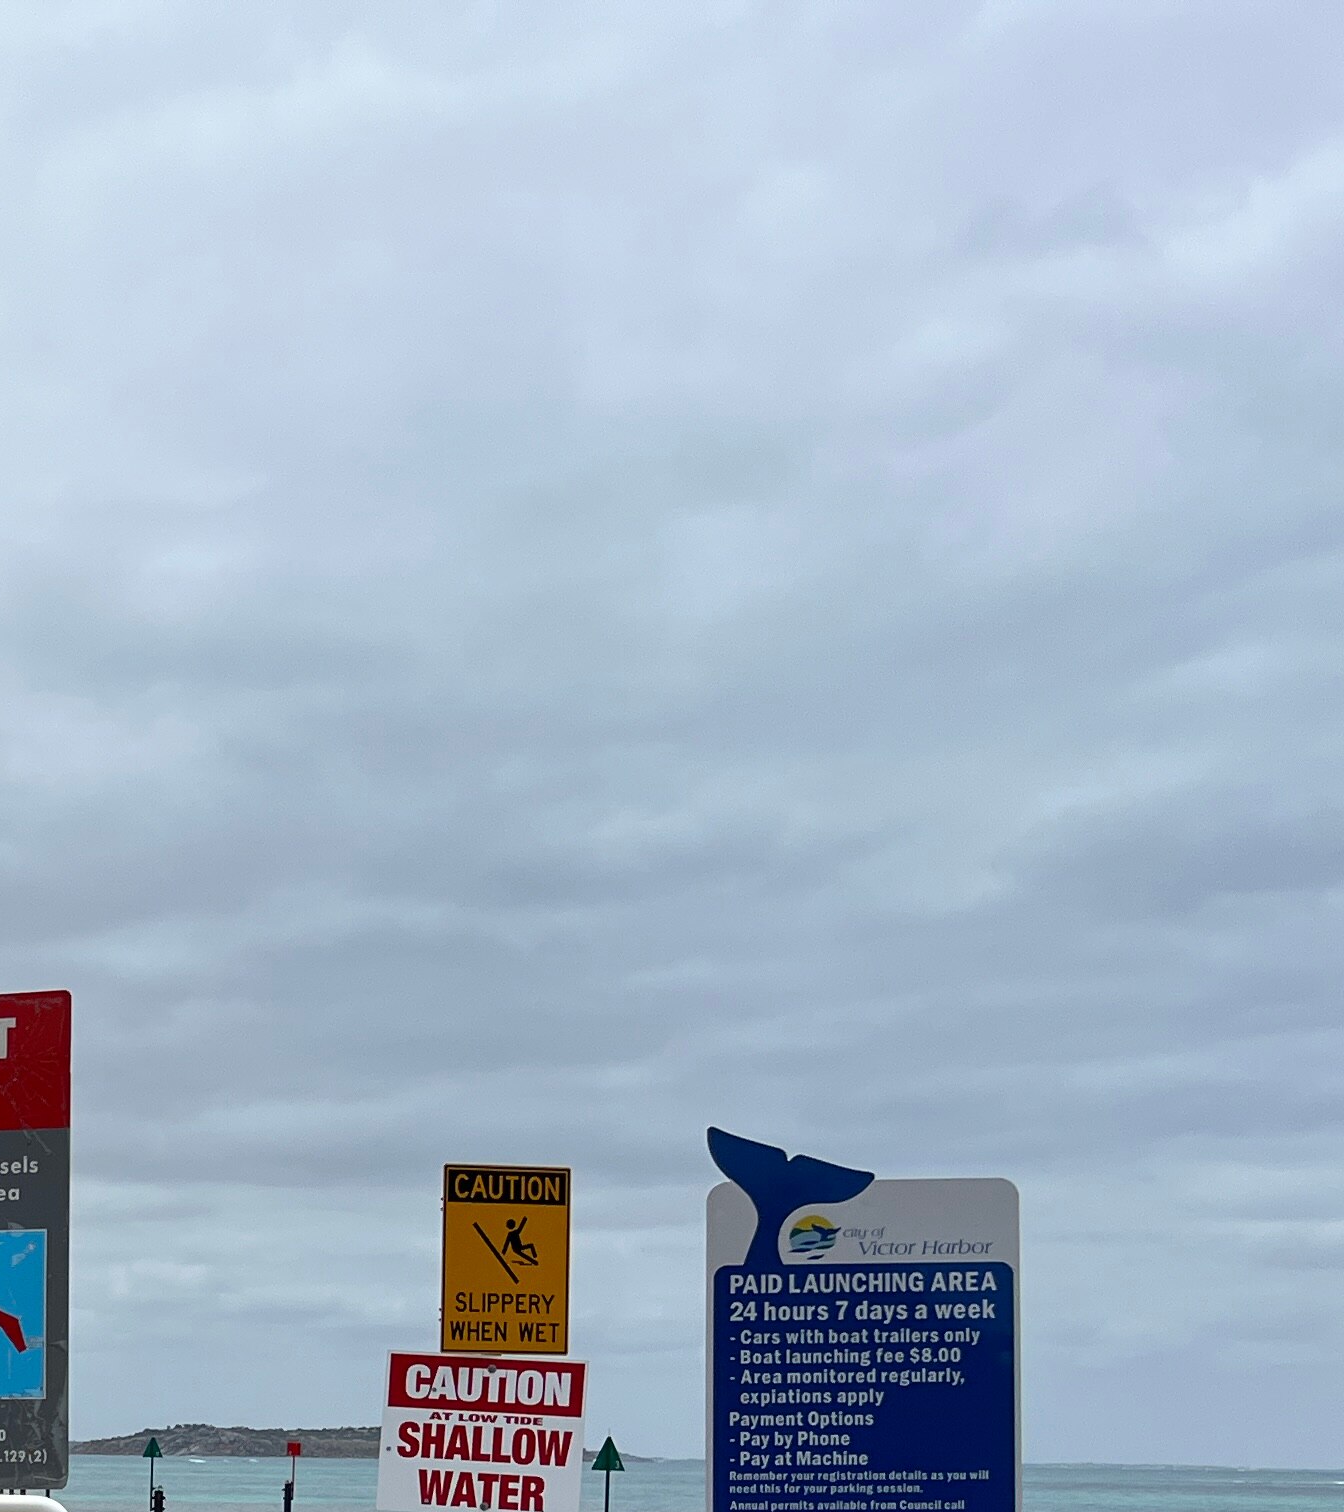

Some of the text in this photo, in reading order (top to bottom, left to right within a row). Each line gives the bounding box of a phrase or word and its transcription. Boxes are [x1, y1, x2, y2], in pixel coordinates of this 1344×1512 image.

[455, 1174, 559, 1200] CAUTION
[871, 1227, 885, 1239] of
[859, 1239, 992, 1255] Victor Harbor
[730, 1272, 996, 1294] PAID LAUNCHING AREA
[456, 1292, 554, 1314] SLIPPERY
[730, 1299, 995, 1324] 24 hours 7 days a week
[450, 1321, 559, 1342] WHEN WET
[406, 1364, 571, 1406] CAUTION
[429, 1412, 543, 1426] AT LOW TIDE
[730, 1411, 873, 1429] Payment Options
[397, 1421, 573, 1467] SHALLOW
[740, 1431, 850, 1449] Pay by Phone
[419, 1469, 544, 1512] WATER
